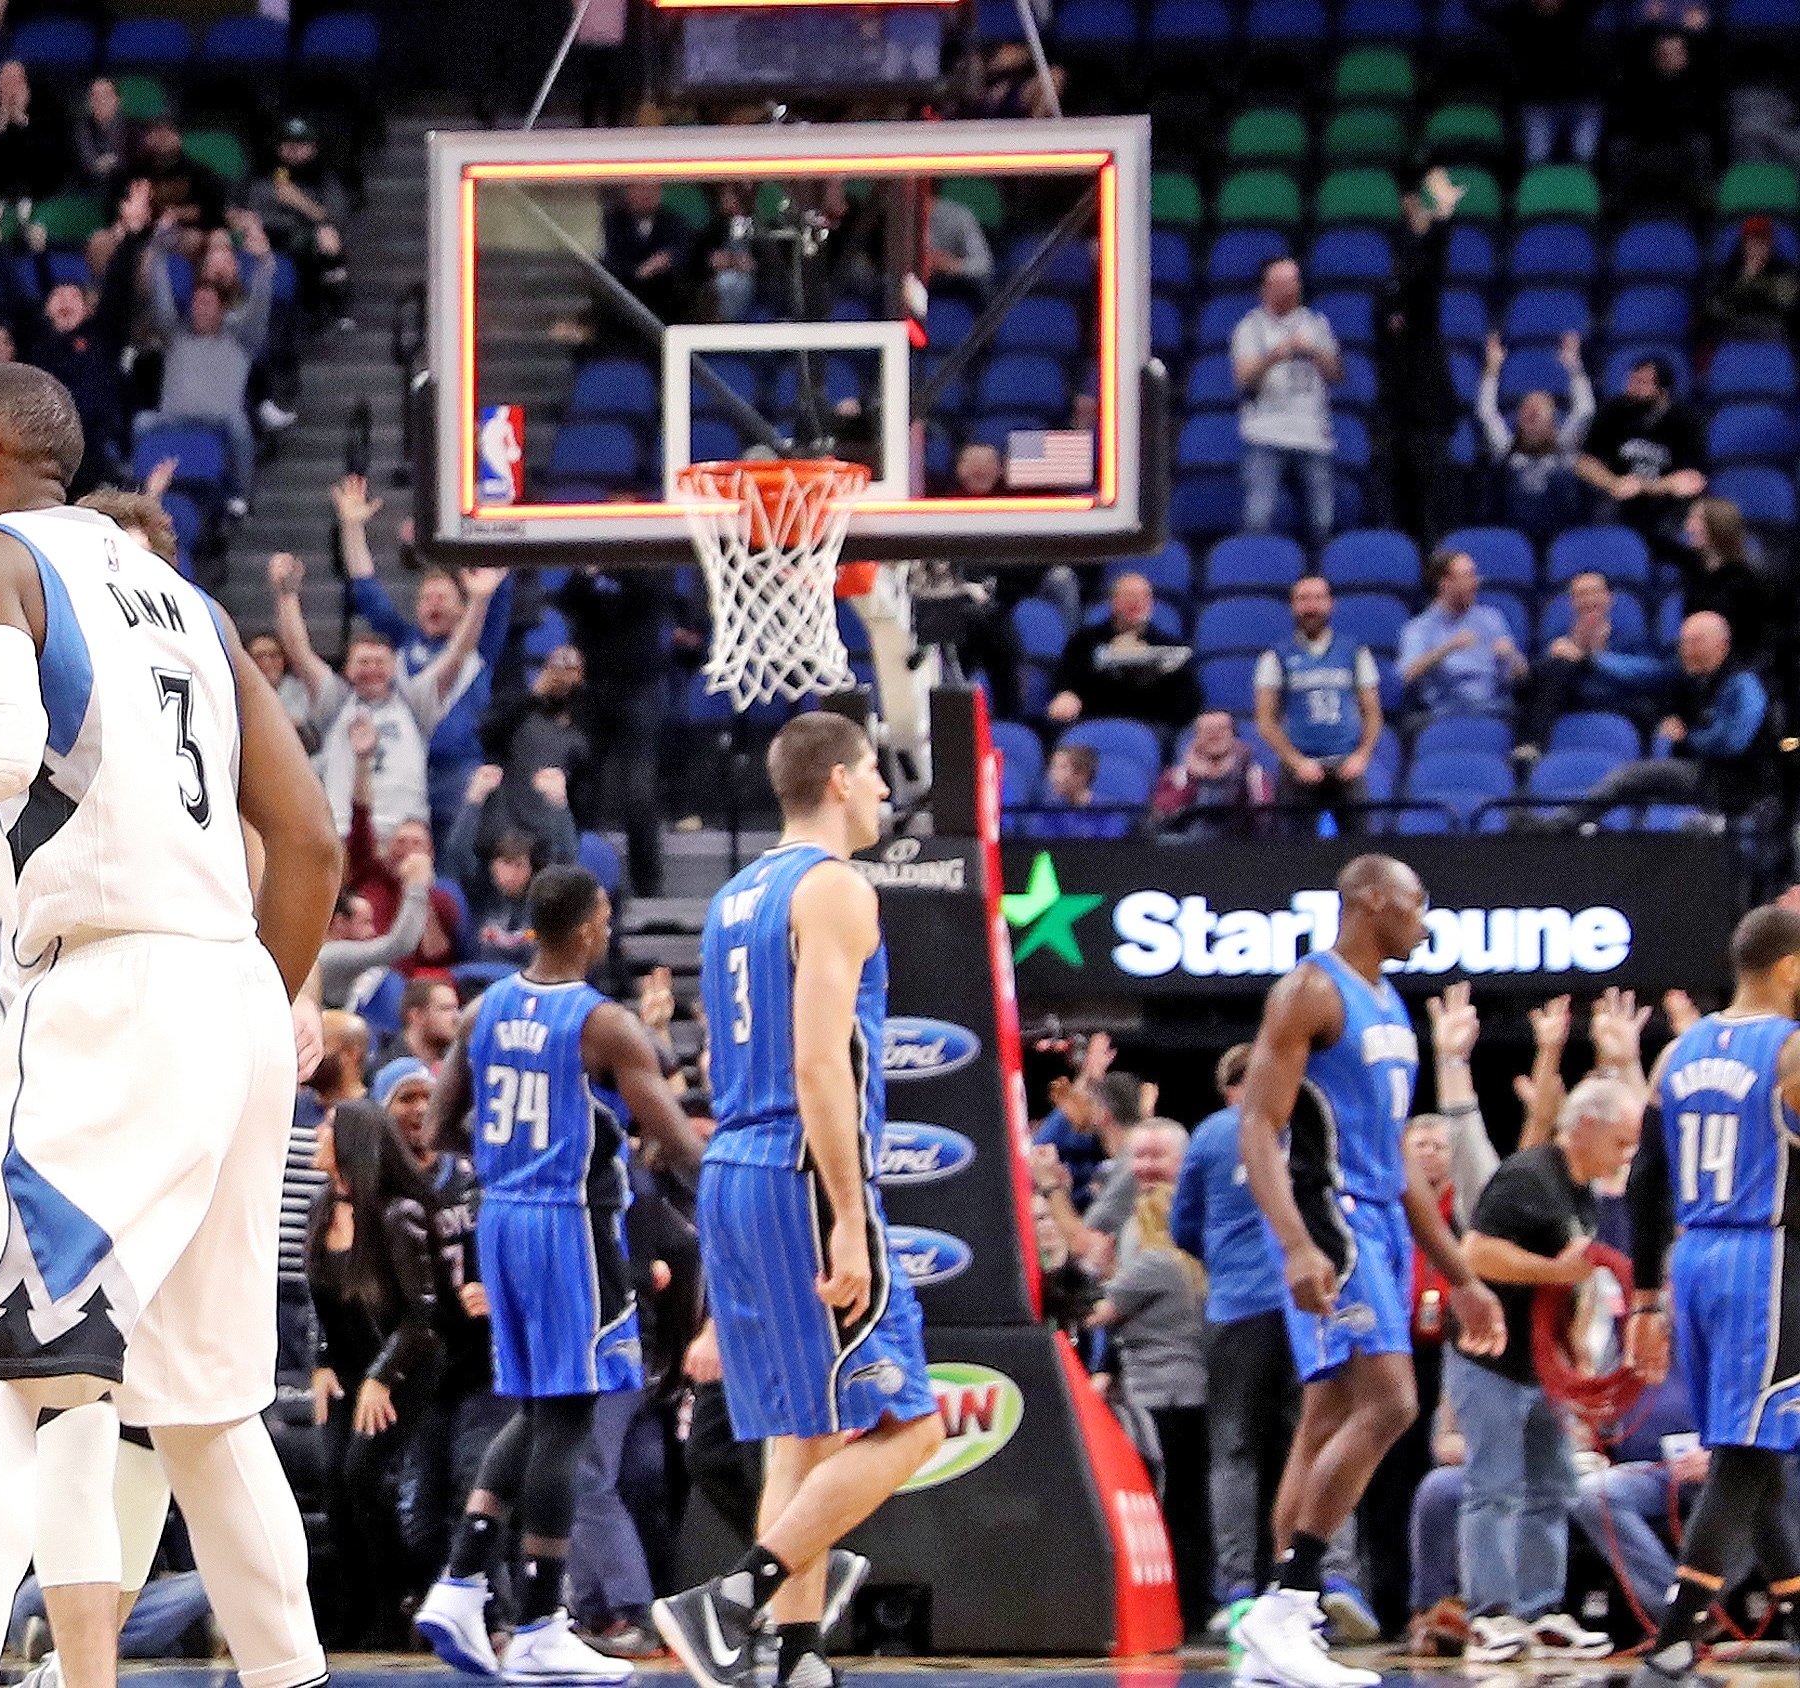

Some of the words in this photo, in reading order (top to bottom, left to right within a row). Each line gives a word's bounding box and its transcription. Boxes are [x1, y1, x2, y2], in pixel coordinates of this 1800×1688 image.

[105, 582, 187, 635] DUNN
[151, 666, 212, 830] 3
[1111, 889, 1633, 977] StarTbune
[728, 945, 753, 1045] 3
[484, 1064, 550, 1150] 34
[1678, 1112, 1741, 1203] 14
